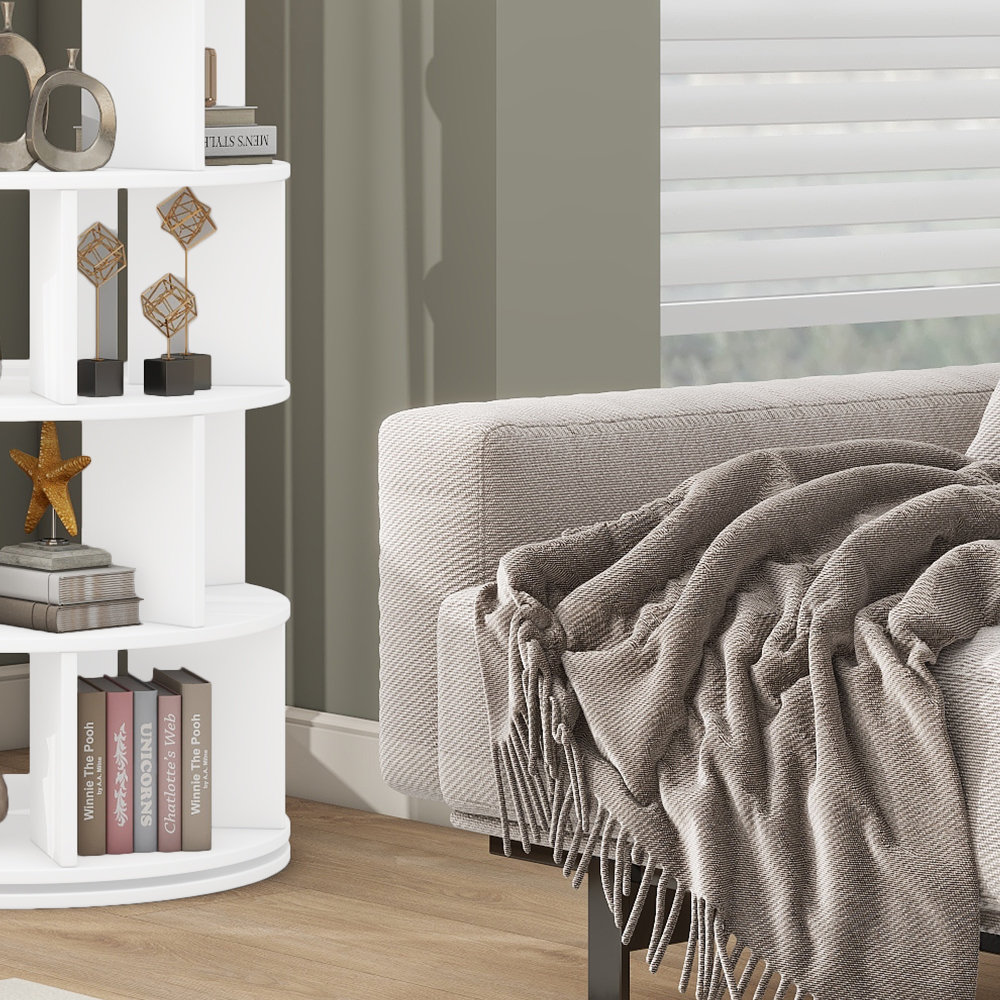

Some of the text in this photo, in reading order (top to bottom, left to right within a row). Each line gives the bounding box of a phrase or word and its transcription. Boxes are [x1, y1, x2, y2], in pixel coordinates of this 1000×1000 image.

[238, 134, 269, 147] MEN'S
[164, 713, 176, 747] Web
[84, 722, 94, 820] Winnie The Pooh
[140, 722, 153, 827] UNICORNS
[191, 714, 201, 816] Winnie The Pooh
[97, 786, 103, 795] by
[203, 780, 209, 789] by
